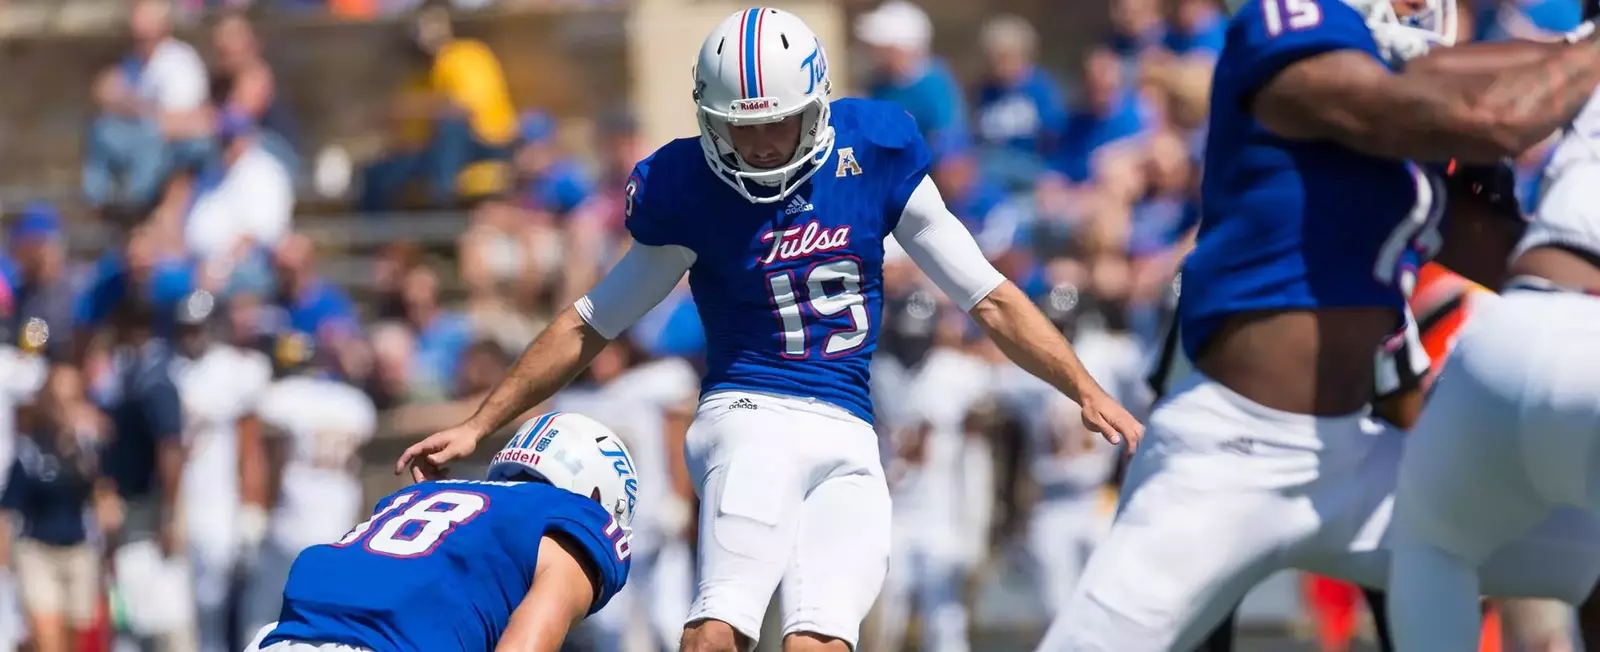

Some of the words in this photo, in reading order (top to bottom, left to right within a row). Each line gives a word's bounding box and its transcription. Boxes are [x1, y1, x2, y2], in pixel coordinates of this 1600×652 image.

[740, 101, 769, 110] Riddell
[836, 147, 862, 177] A
[785, 203, 814, 215] adidas
[757, 219, 851, 266] Tulsa
[766, 255, 870, 359] 19
[729, 402, 758, 410] adidas
[493, 450, 541, 465] Riddell
[329, 489, 490, 558] 18
